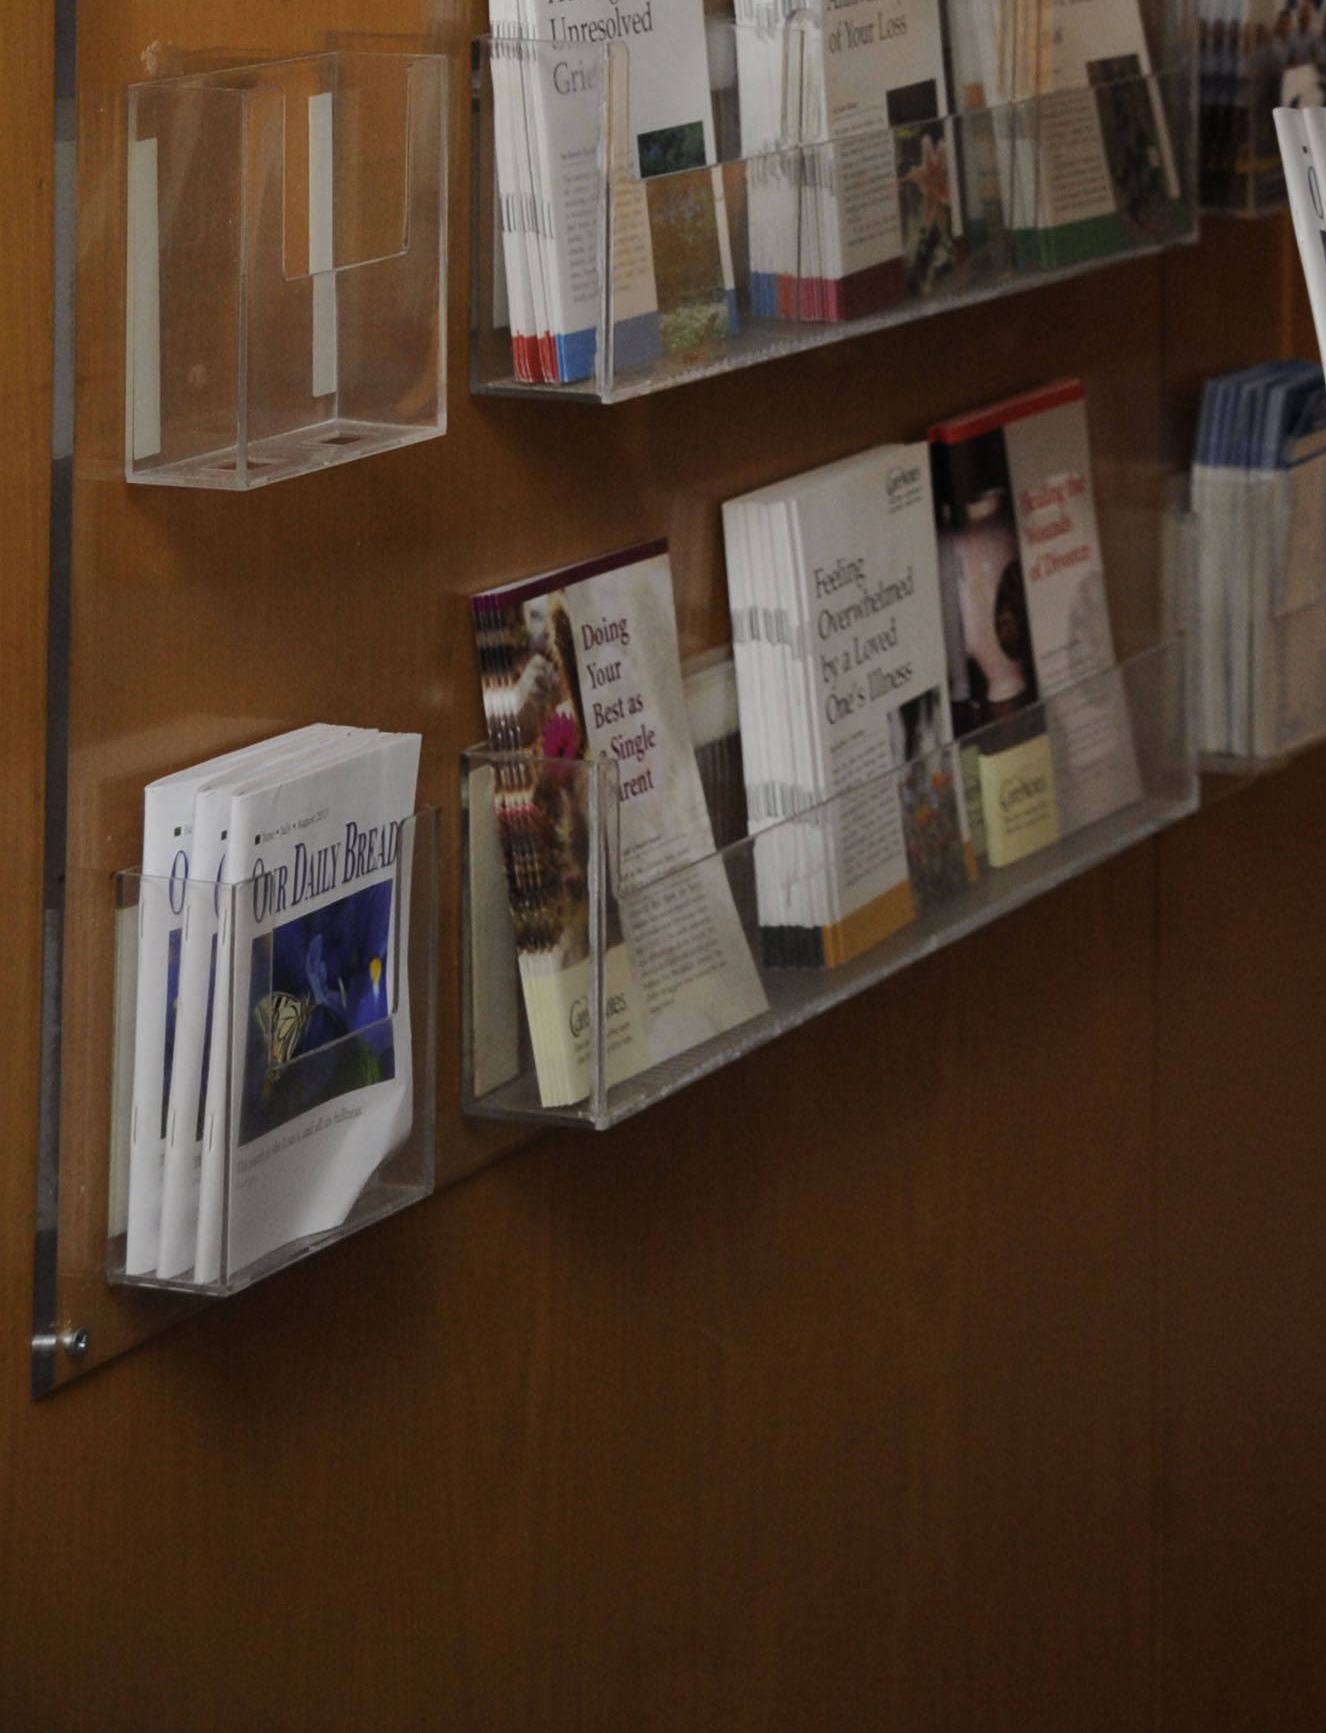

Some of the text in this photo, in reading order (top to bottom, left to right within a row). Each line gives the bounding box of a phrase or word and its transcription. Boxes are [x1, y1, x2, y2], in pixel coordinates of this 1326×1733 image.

[550, 1, 654, 51] Unresolved
[828, 11, 908, 54] of Your Loss
[813, 557, 866, 599] Feeling
[817, 564, 916, 641] Overwhelmed
[580, 617, 631, 652] Doing
[852, 614, 899, 666] Loved
[585, 661, 623, 690] Your
[866, 660, 914, 702] Illness
[592, 693, 645, 730] Best as
[610, 723, 657, 763] Single
[252, 858, 289, 924] OUR
[290, 842, 342, 907] DAILY
[341, 820, 400, 886] BREAD
